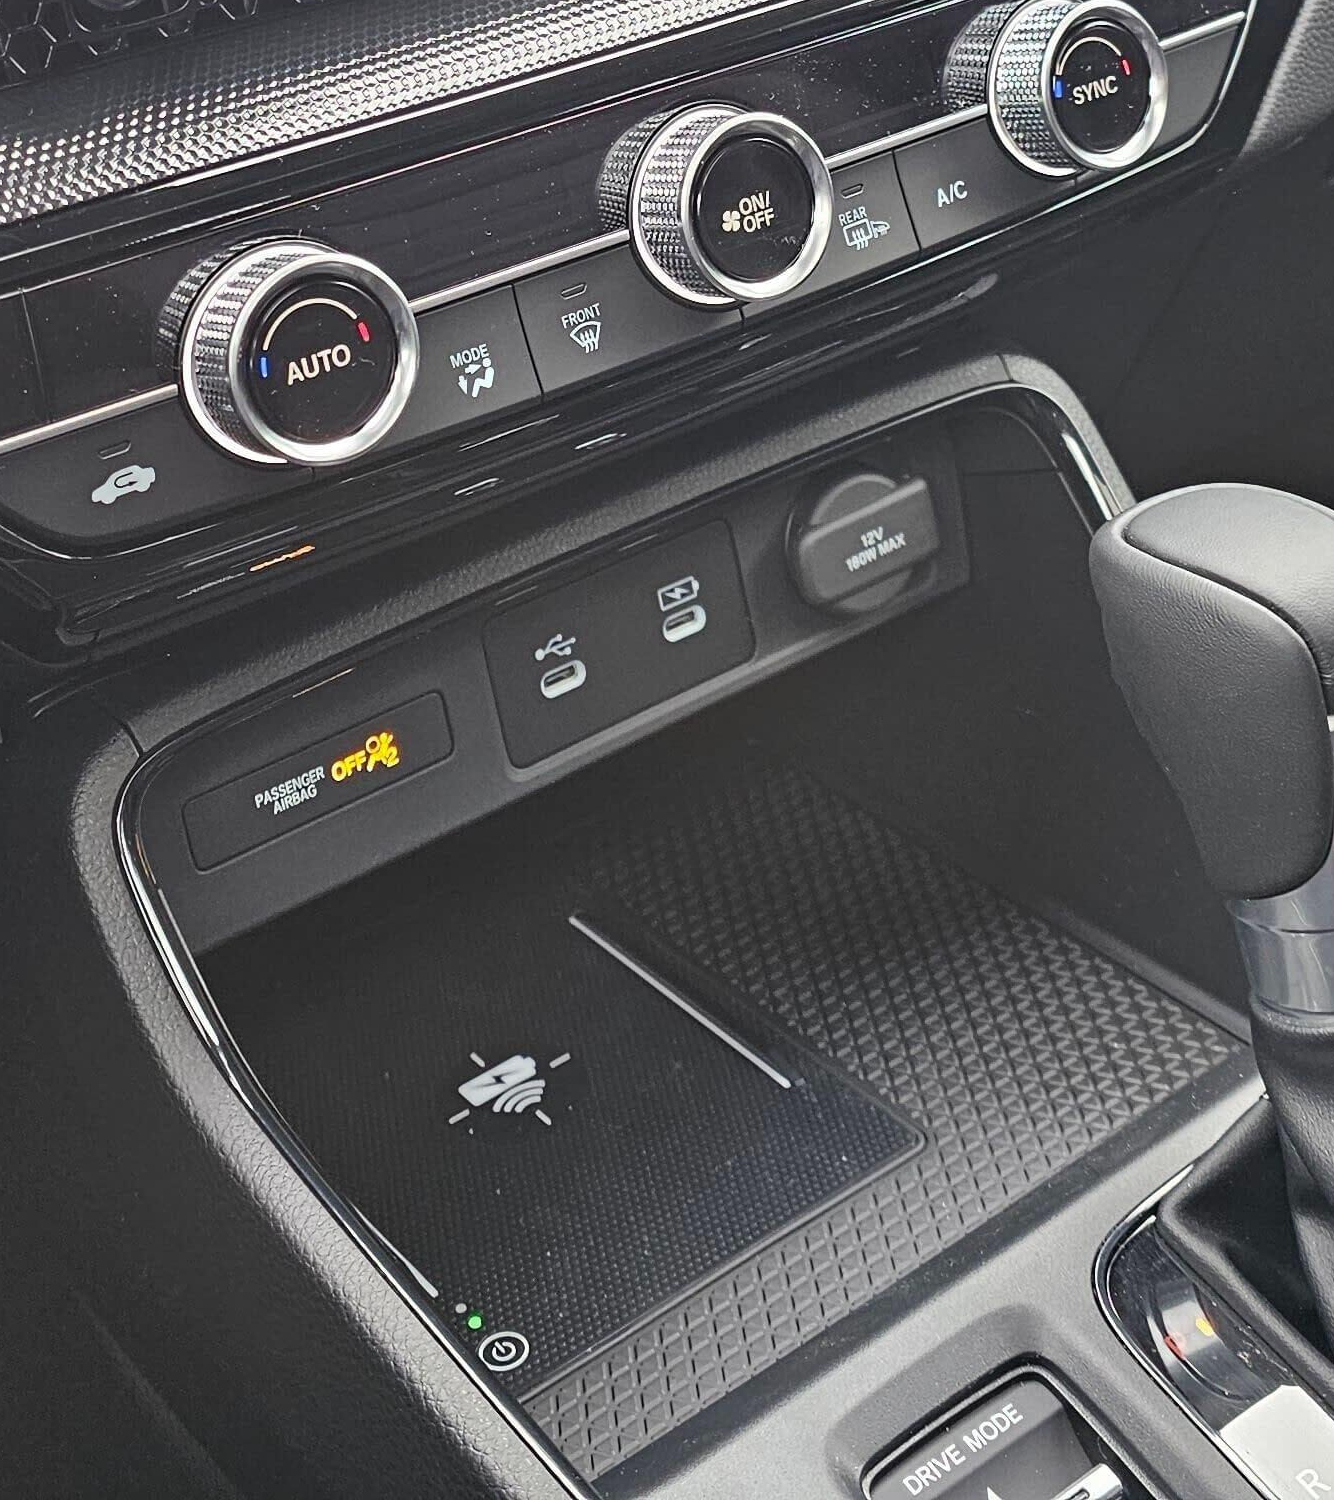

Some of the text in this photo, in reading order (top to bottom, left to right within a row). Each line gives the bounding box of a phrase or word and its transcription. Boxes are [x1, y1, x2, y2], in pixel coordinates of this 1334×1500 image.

[1073, 75, 1119, 106] SYNC
[739, 192, 772, 211] ON/
[936, 179, 969, 207] A/C
[743, 208, 776, 231] OFF
[838, 206, 868, 228] REAR
[561, 302, 603, 328] FRONT
[285, 343, 352, 385] AUTO
[450, 343, 491, 369] MODE
[860, 526, 884, 547] 12V
[845, 533, 907, 573] 180W MAX
[331, 749, 367, 782] OFF
[254, 765, 325, 809] PASSENGER
[273, 784, 318, 815] AIRBAG
[901, 1402, 1025, 1498] DRIVE MODE
[1294, 1467, 1332, 1500] R
